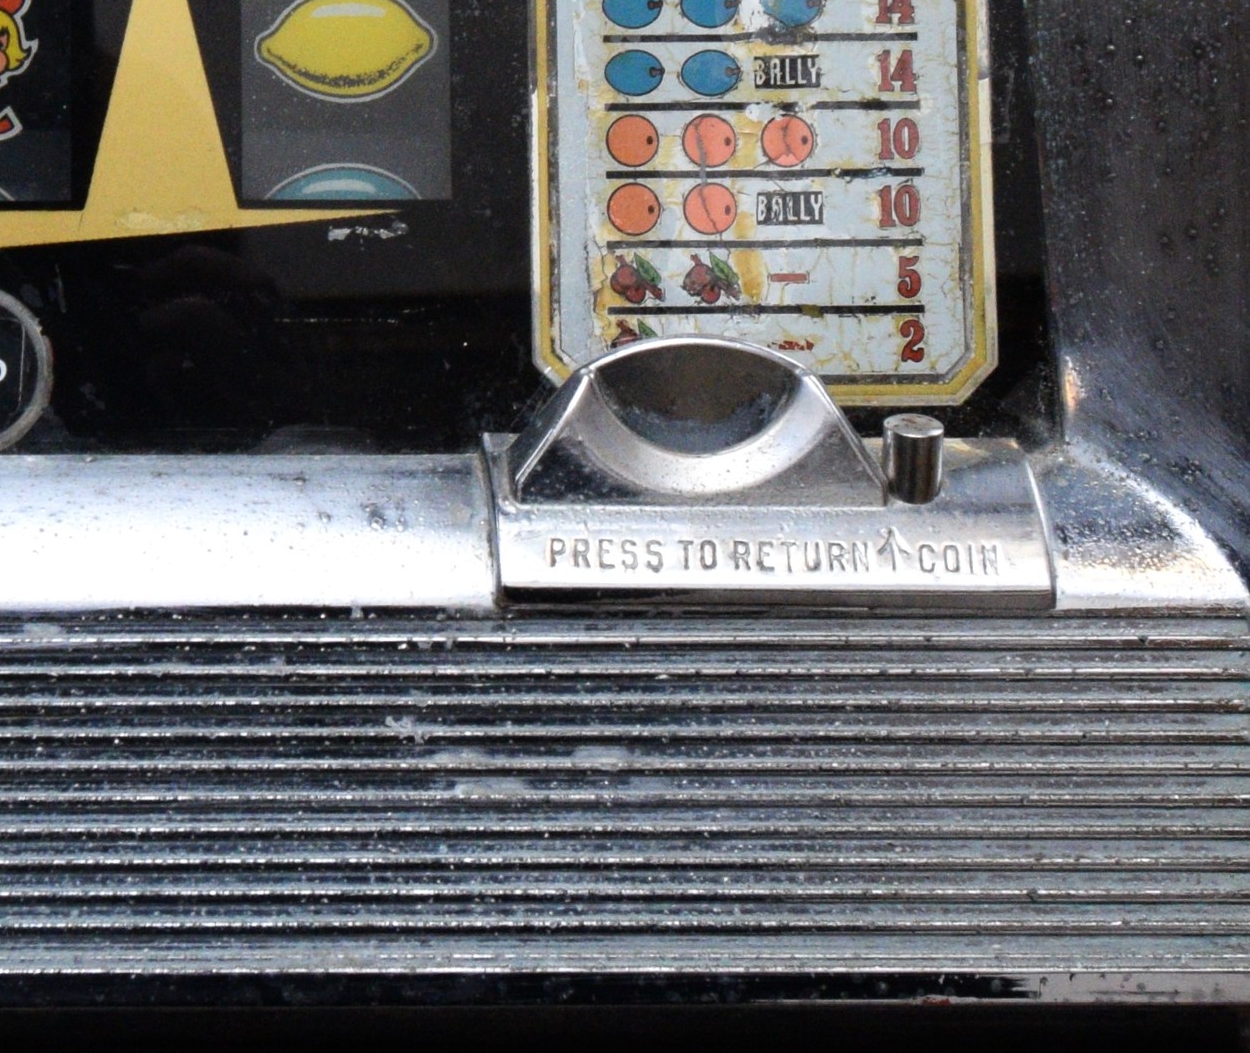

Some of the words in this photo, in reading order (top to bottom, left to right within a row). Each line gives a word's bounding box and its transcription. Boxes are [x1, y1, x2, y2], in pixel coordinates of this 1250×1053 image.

[877, 49, 917, 92] 14
[877, 117, 920, 161] 10
[878, 184, 921, 228] 10
[897, 255, 922, 299] 5
[899, 319, 925, 363] 2
[549, 537, 664, 573] PRESS
[678, 539, 717, 570] TO
[733, 539, 869, 573] RETURN
[919, 542, 1000, 575] COIN
